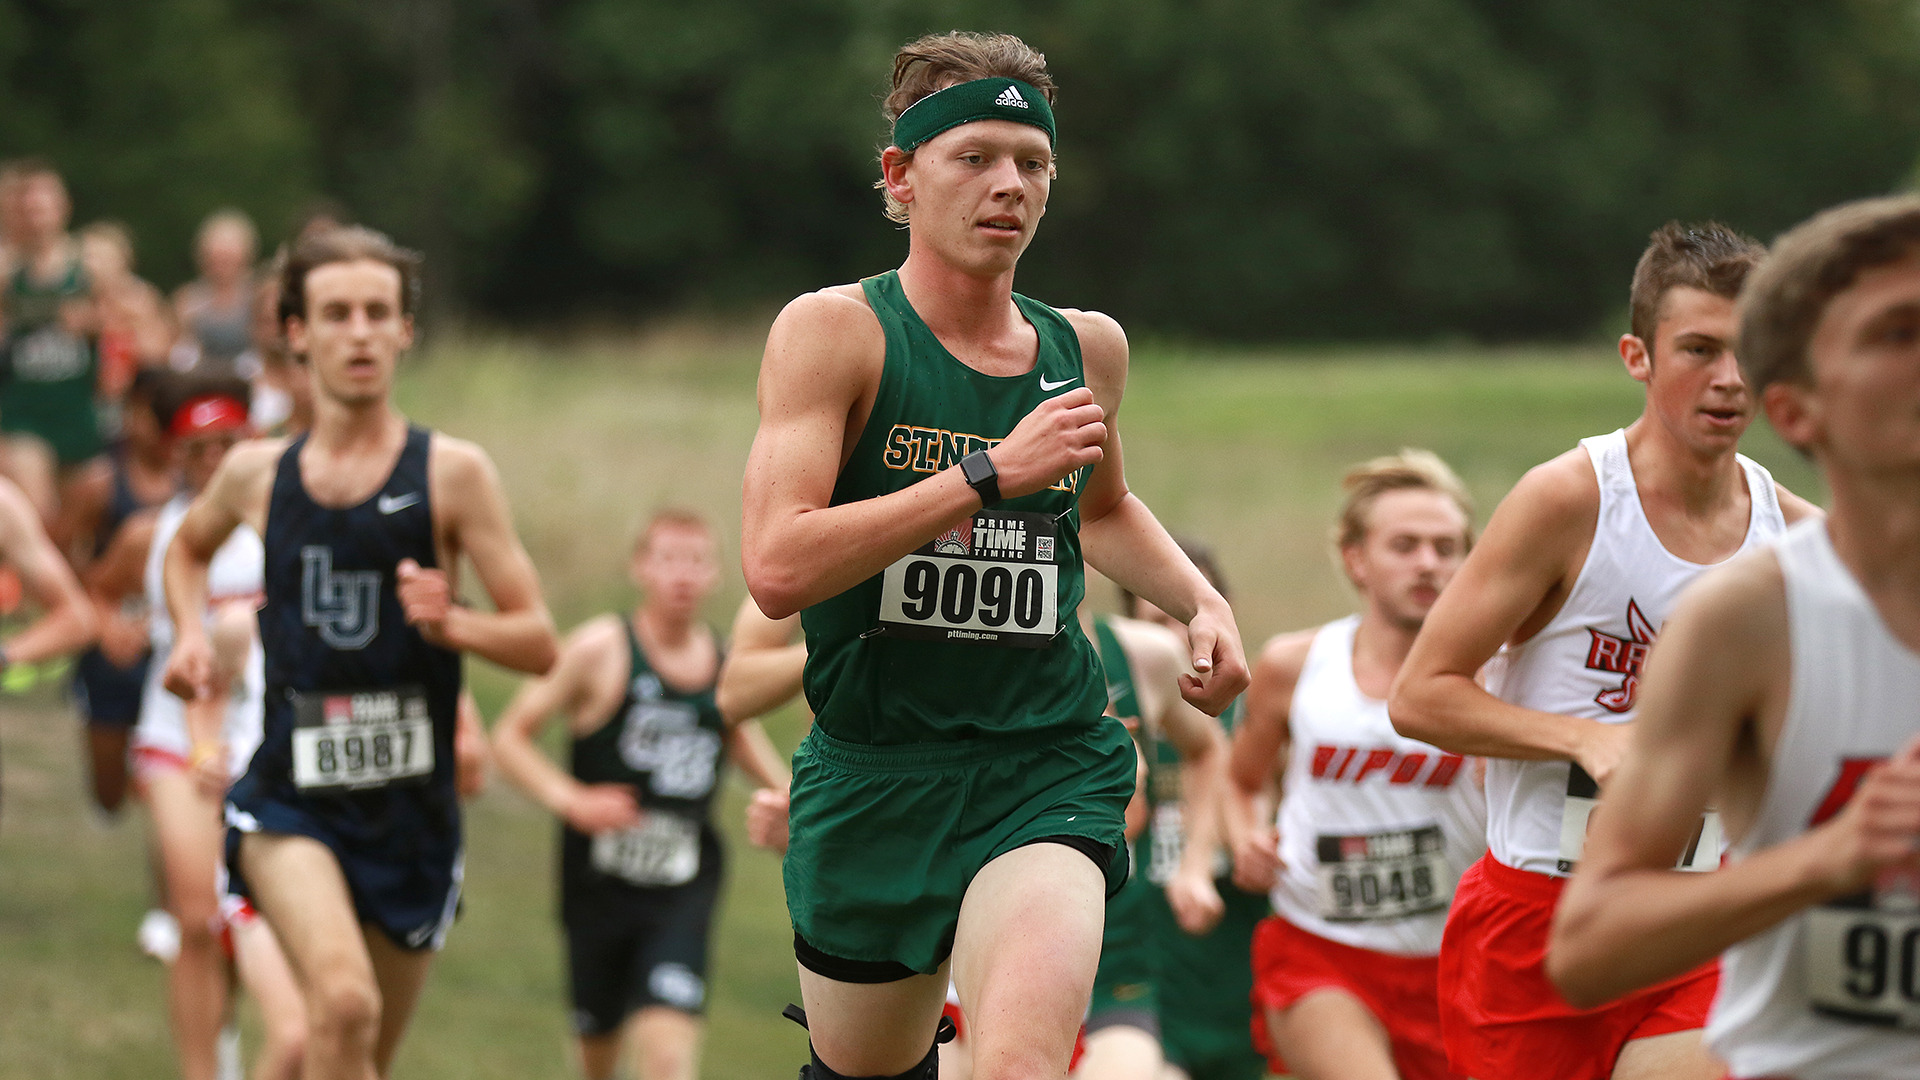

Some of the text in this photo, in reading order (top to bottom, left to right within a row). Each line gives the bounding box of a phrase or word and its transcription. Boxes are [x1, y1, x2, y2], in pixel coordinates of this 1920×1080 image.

[994, 98, 1029, 109] adidas
[977, 518, 1025, 530] PRIME
[973, 527, 1027, 551] TIME
[974, 549, 1023, 559] TIMING
[901, 560, 1043, 629] 9090
[947, 630, 998, 641] pttiming.com
[317, 731, 412, 774] 8987
[1311, 745, 1464, 787] RIPON
[1331, 865, 1433, 908] 9048
